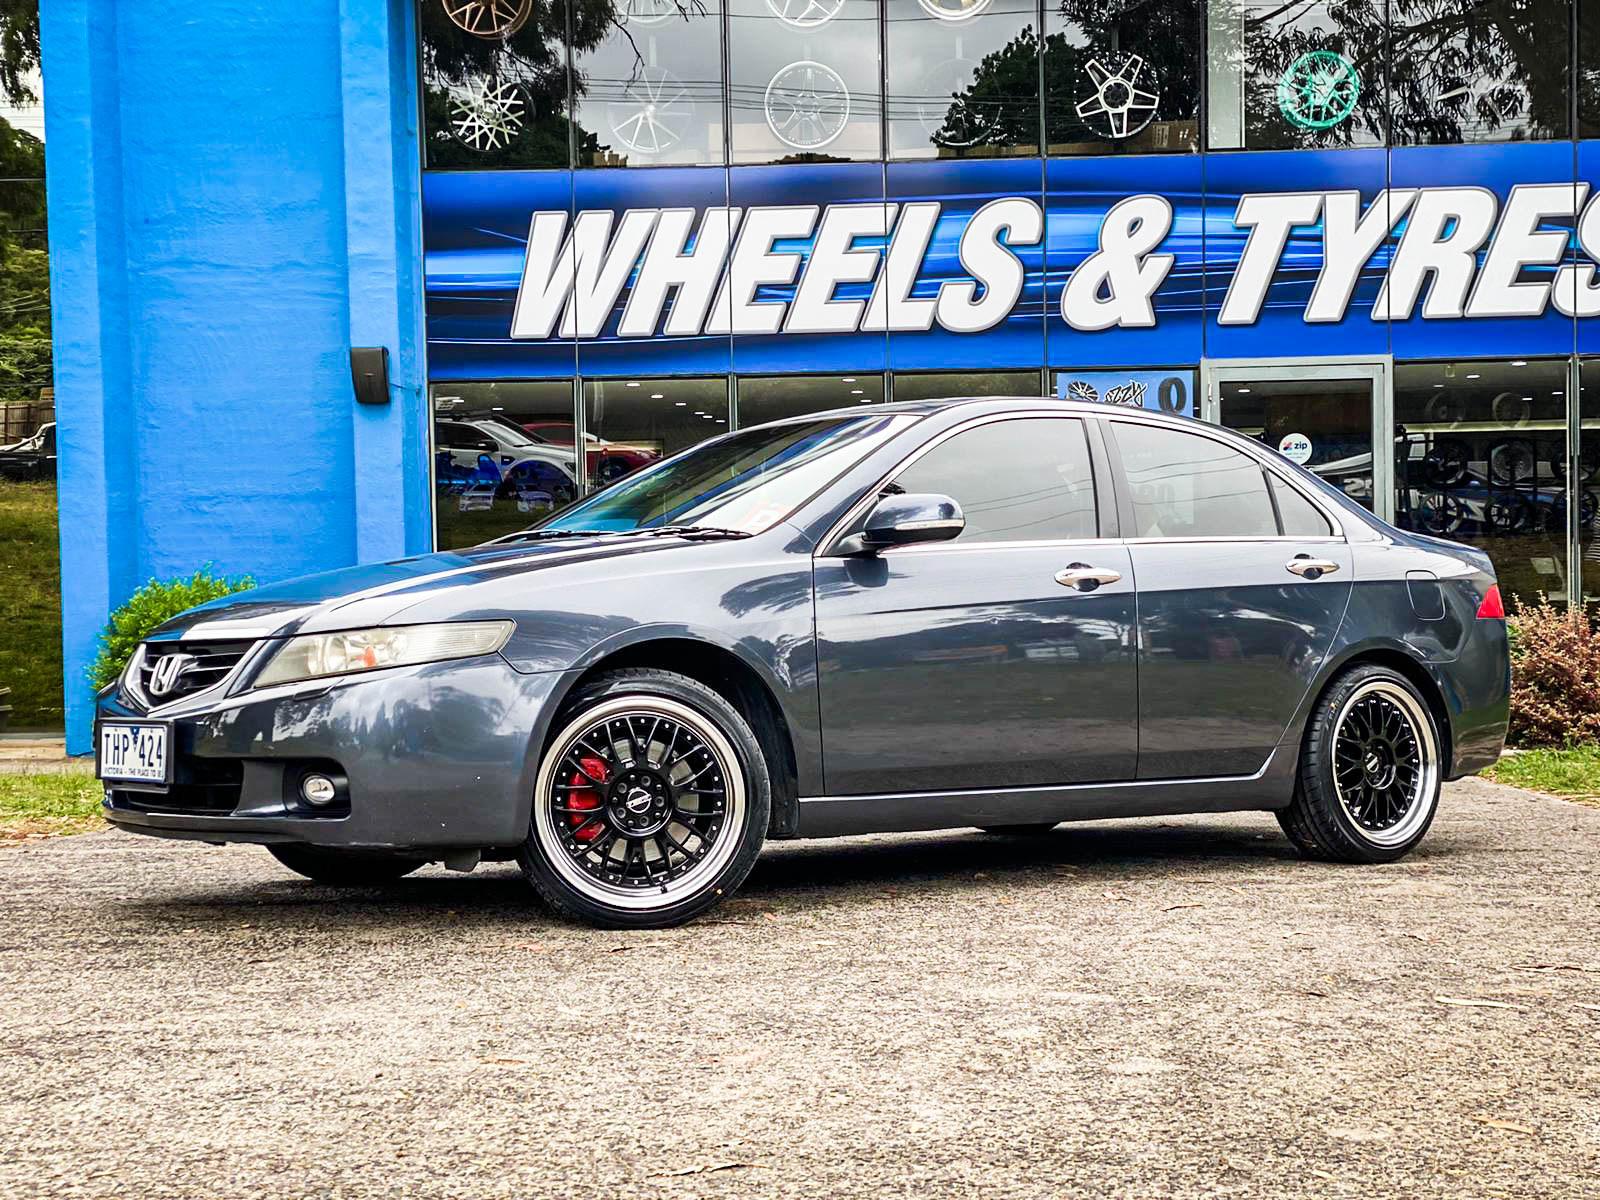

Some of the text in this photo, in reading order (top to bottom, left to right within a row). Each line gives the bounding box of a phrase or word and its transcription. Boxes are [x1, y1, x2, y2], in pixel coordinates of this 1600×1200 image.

[509, 197, 1043, 339] WHEELS
[1060, 194, 1175, 331] &
[1294, 441, 1308, 451] zip
[104, 733, 162, 768] THP 424
